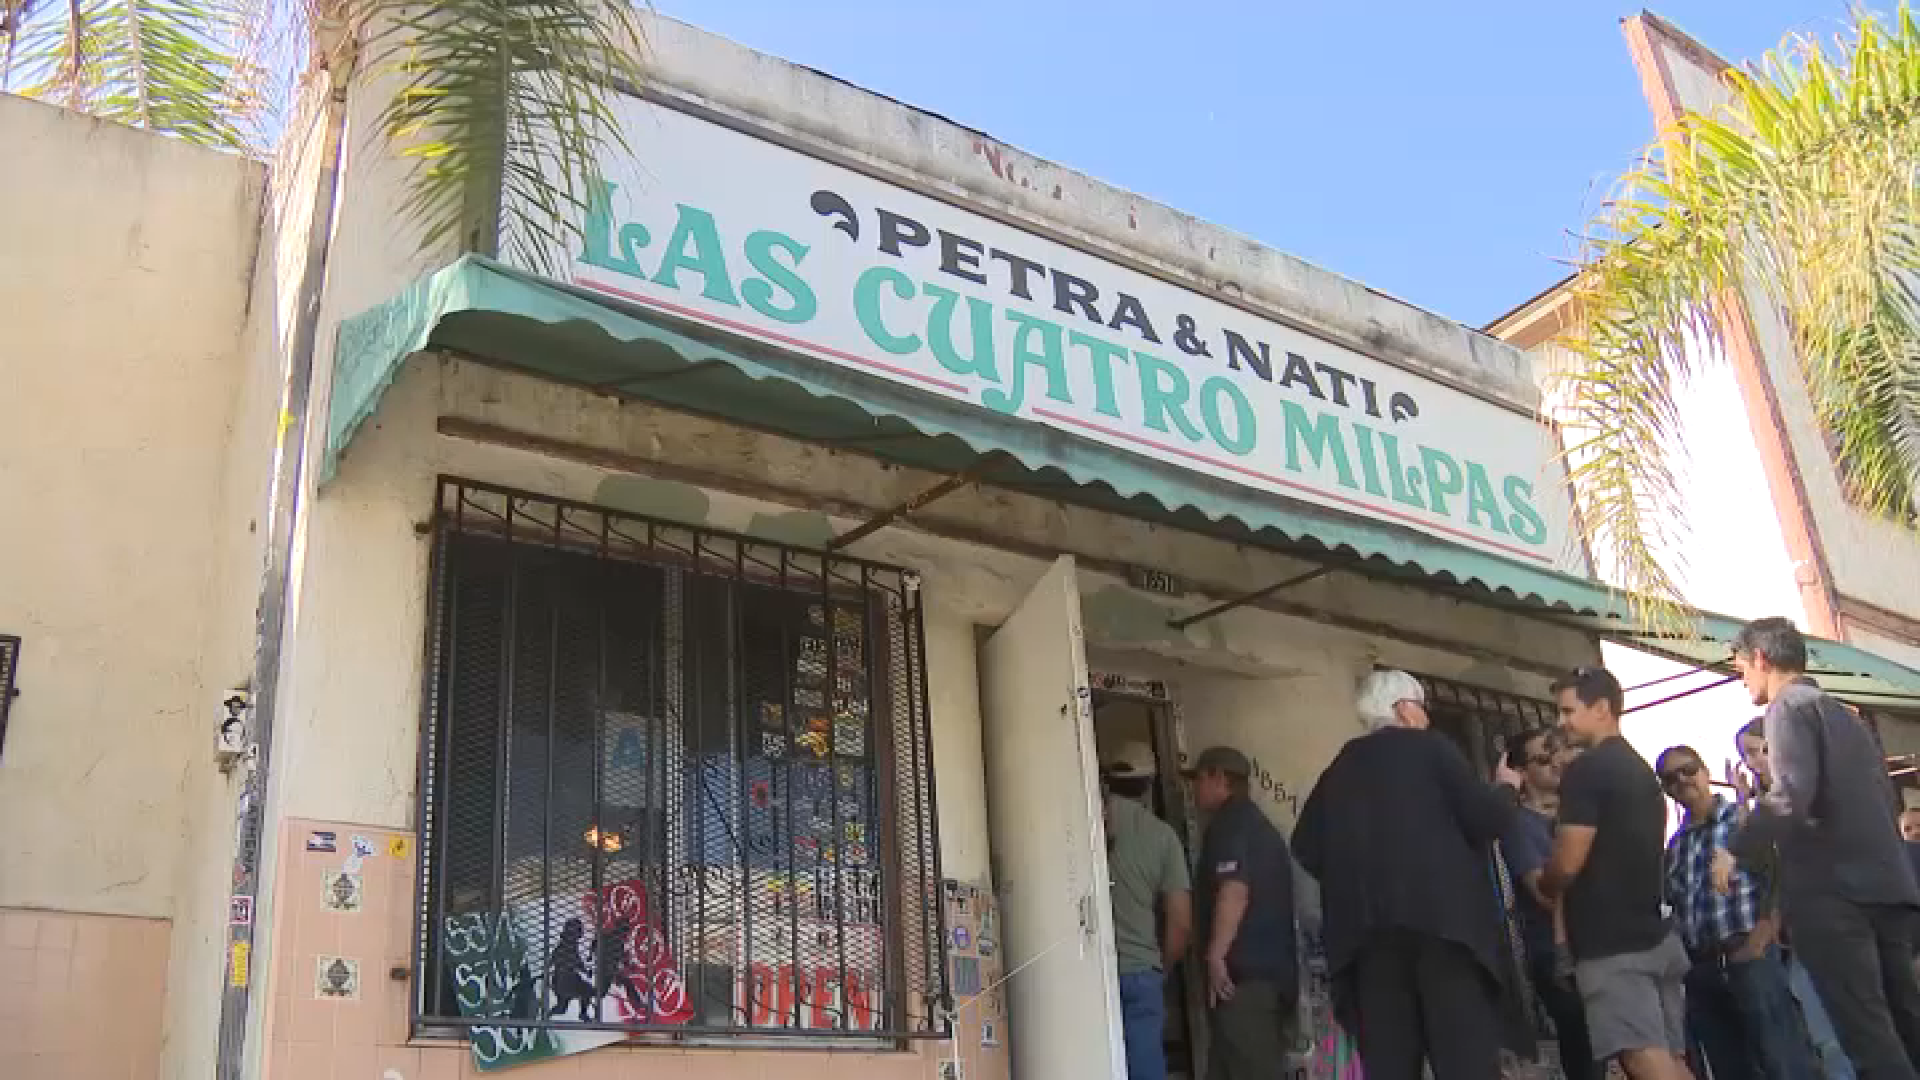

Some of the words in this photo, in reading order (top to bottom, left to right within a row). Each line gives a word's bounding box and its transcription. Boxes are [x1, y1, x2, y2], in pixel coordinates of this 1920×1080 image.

[577, 180, 817, 324] LAS
[853, 265, 1257, 457] CUATRO
[1281, 399, 1548, 546] MILPAS
[874, 207, 1161, 344] PETRA
[1173, 313, 1210, 358] &
[1222, 328, 1380, 418] NATI
